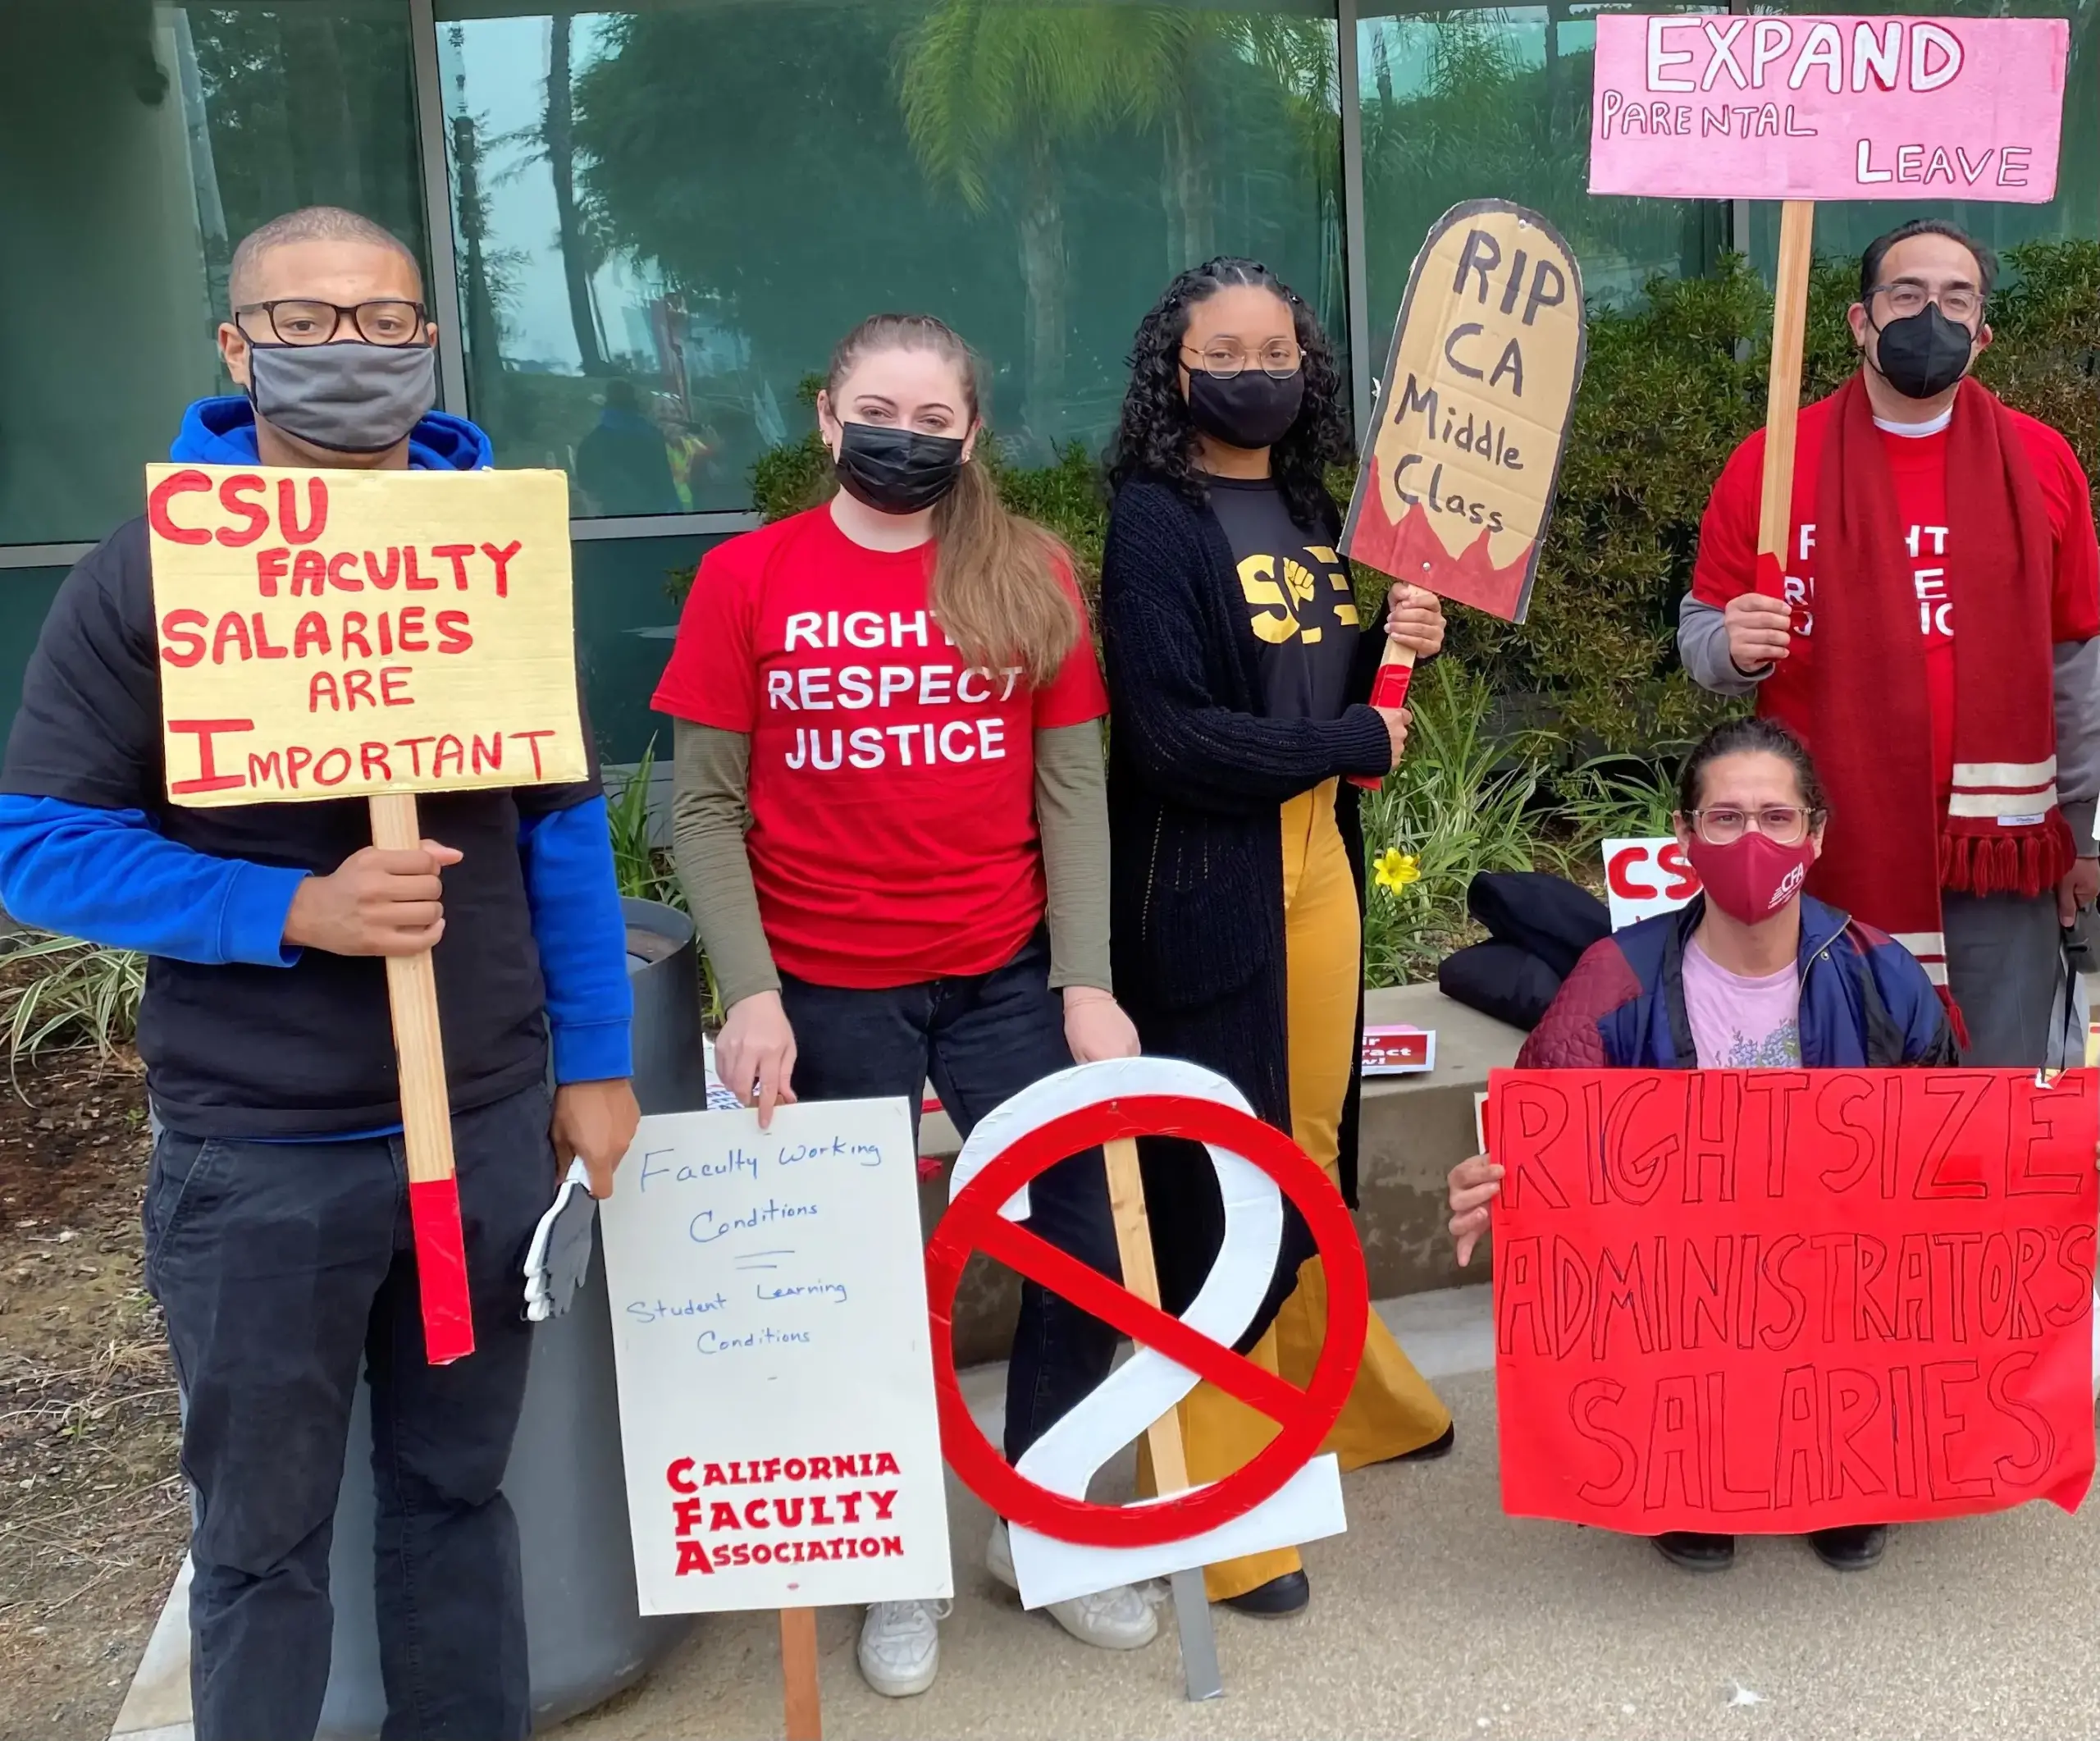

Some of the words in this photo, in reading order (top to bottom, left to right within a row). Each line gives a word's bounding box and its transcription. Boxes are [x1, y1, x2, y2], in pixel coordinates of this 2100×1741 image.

[1646, 16, 1965, 94] EXPAND
[1601, 89, 1818, 139] PARENTAL
[1856, 139, 2032, 187] LEAVE
[1452, 229, 1565, 326] RIP
[1444, 322, 1523, 397] CA
[1394, 373, 1524, 470] Middle
[148, 469, 328, 547] CSU
[1393, 454, 1504, 533] Class
[256, 540, 522, 598] FACULTY
[161, 605, 474, 667] SALARIES
[784, 610, 956, 652] RIGH
[308, 666, 414, 713] ARE
[167, 719, 556, 794] IMPORTANT
[785, 718, 1006, 770] JUSTICE
[1608, 843, 1704, 901] CS
[1781, 861, 1804, 893] CFA
[640, 1148, 760, 1193] Faculty
[689, 1200, 819, 1243] Conditions
[626, 1294, 727, 1324] Student
[756, 1278, 848, 1303] Learning
[1498, 1223, 2097, 1361] ADMINISTRATOR'S
[696, 1326, 811, 1355] Conditions
[1568, 1350, 2057, 1513] SALARIES
[666, 1451, 901, 1495] CALIFORNIA
[672, 1489, 899, 1537] FACULTY
[674, 1534, 904, 1577] ASSOCIATION
